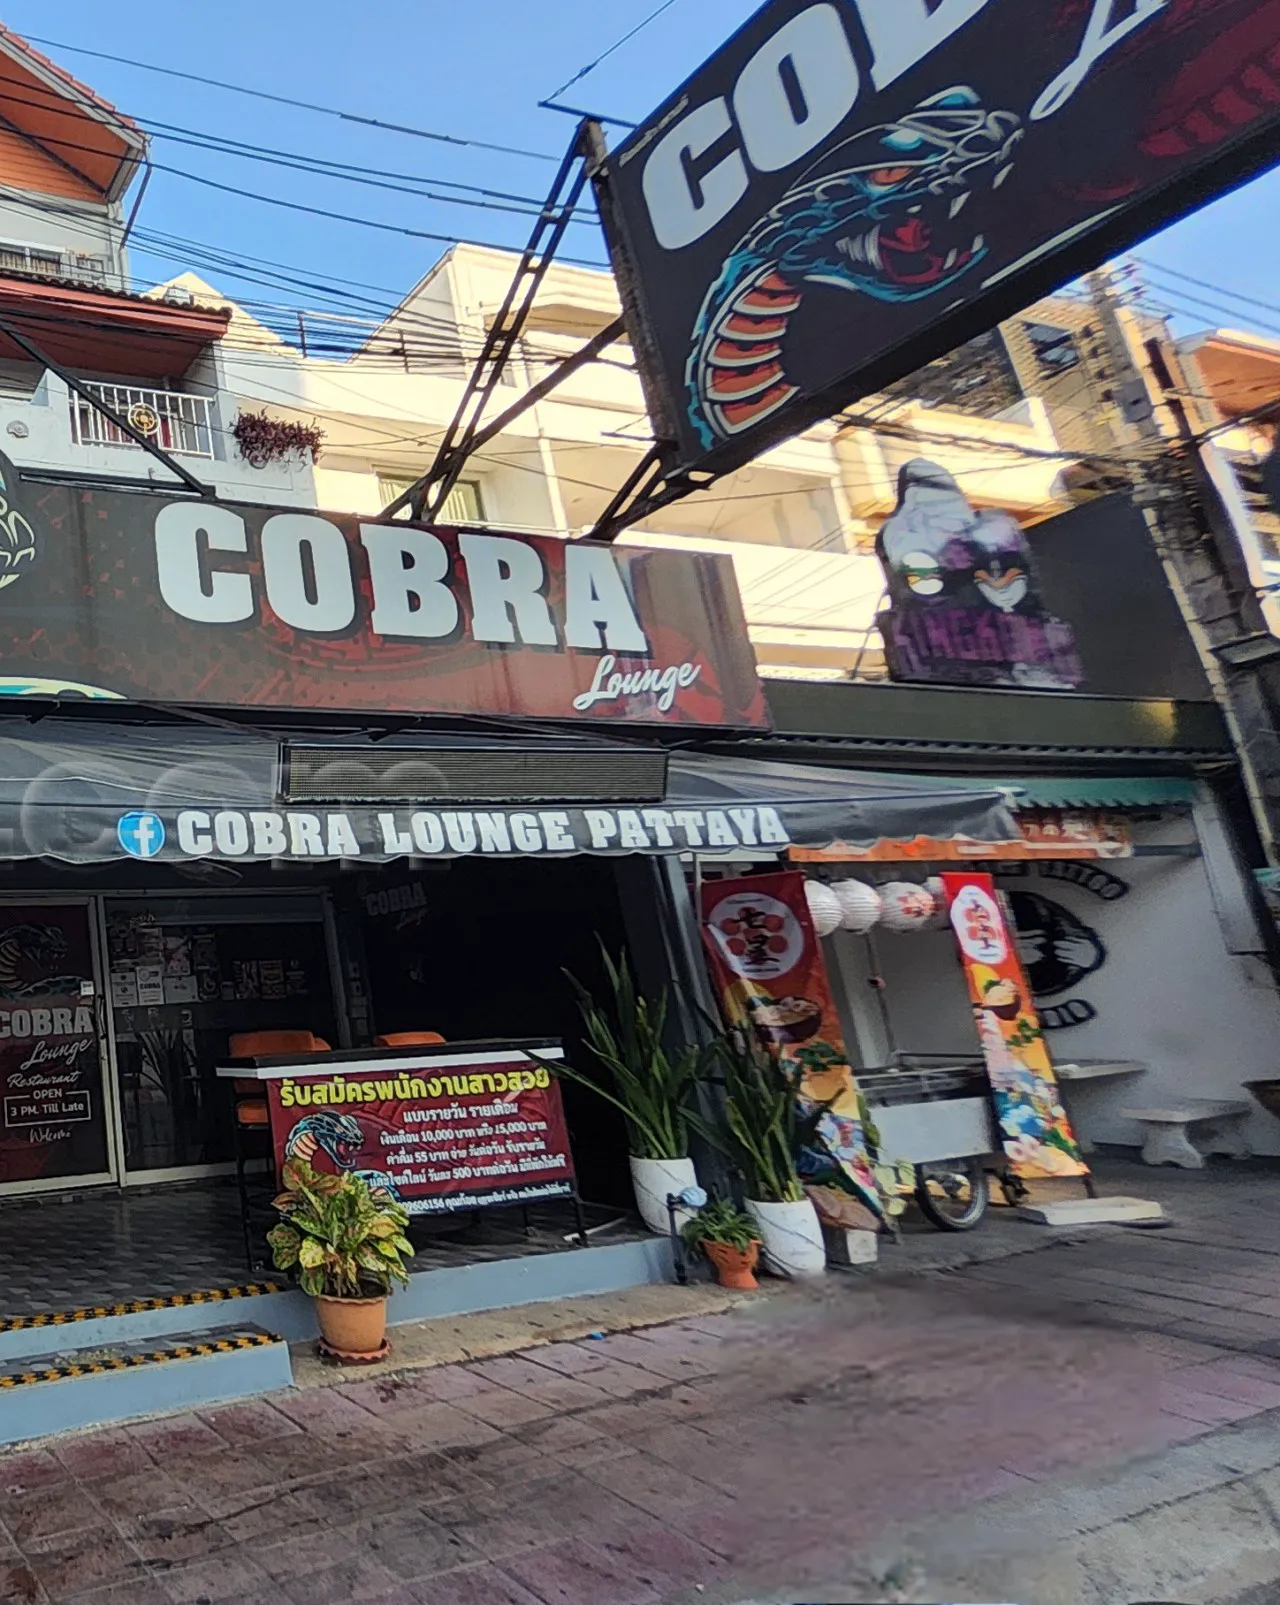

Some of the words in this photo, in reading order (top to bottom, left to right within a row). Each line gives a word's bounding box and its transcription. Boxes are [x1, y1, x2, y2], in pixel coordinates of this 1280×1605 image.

[154, 501, 650, 652] COBRA
[574, 655, 702, 712] Lounge
[177, 811, 361, 856] COBRA
[383, 809, 576, 855] LOUNGE
[591, 806, 791, 849] PATTAYA
[20, 1039, 93, 1070] Lounge
[7, 1070, 83, 1089] Restaurant
[280, 1067, 551, 1107] รับสมัครพนักงานสาวสวย
[33, 1088, 63, 1100] OPEN
[10, 1106, 18, 1117] 3
[42, 1103, 59, 1114] Till
[61, 1102, 85, 1113] Late
[421, 1128, 454, 1143] 10,000
[495, 1121, 527, 1136] 15,000
[414, 1151, 428, 1163] 55
[452, 1167, 472, 1179] 500
